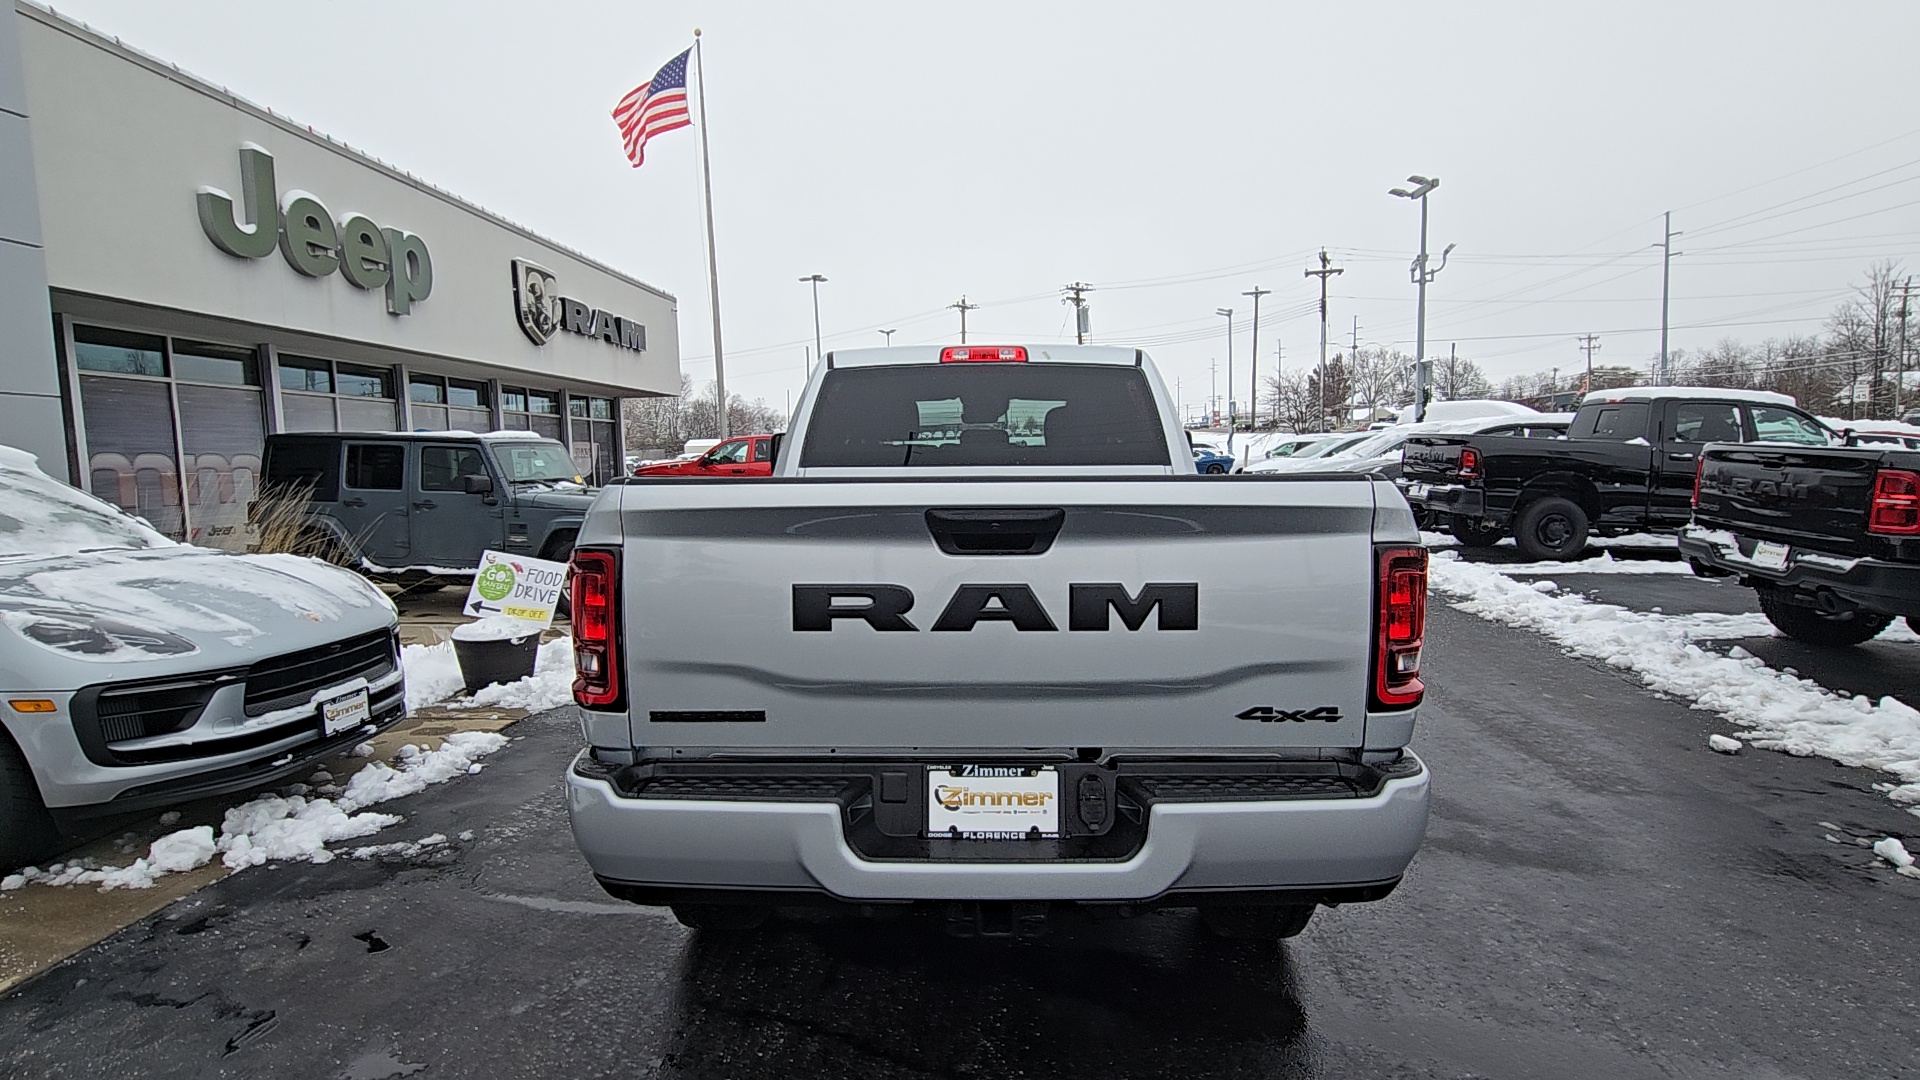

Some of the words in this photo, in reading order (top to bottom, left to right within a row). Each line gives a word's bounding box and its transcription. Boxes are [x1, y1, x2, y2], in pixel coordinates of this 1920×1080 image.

[197, 143, 433, 316] Jeep
[558, 297, 647, 351] RAM
[1412, 451, 1445, 463] RAM
[1731, 478, 1809, 499] RAM
[486, 569, 506, 581] GO
[526, 568, 563, 587] FOOD
[514, 584, 558, 604] DRIVE
[529, 609, 545, 618] OFF
[792, 582, 1199, 632] RAM
[327, 701, 366, 719] Zimmer
[1234, 706, 1344, 723] 4x4
[962, 764, 1025, 777] Zimmer
[942, 786, 1054, 807] Zimmer
[962, 832, 1027, 840] FLORENCE
